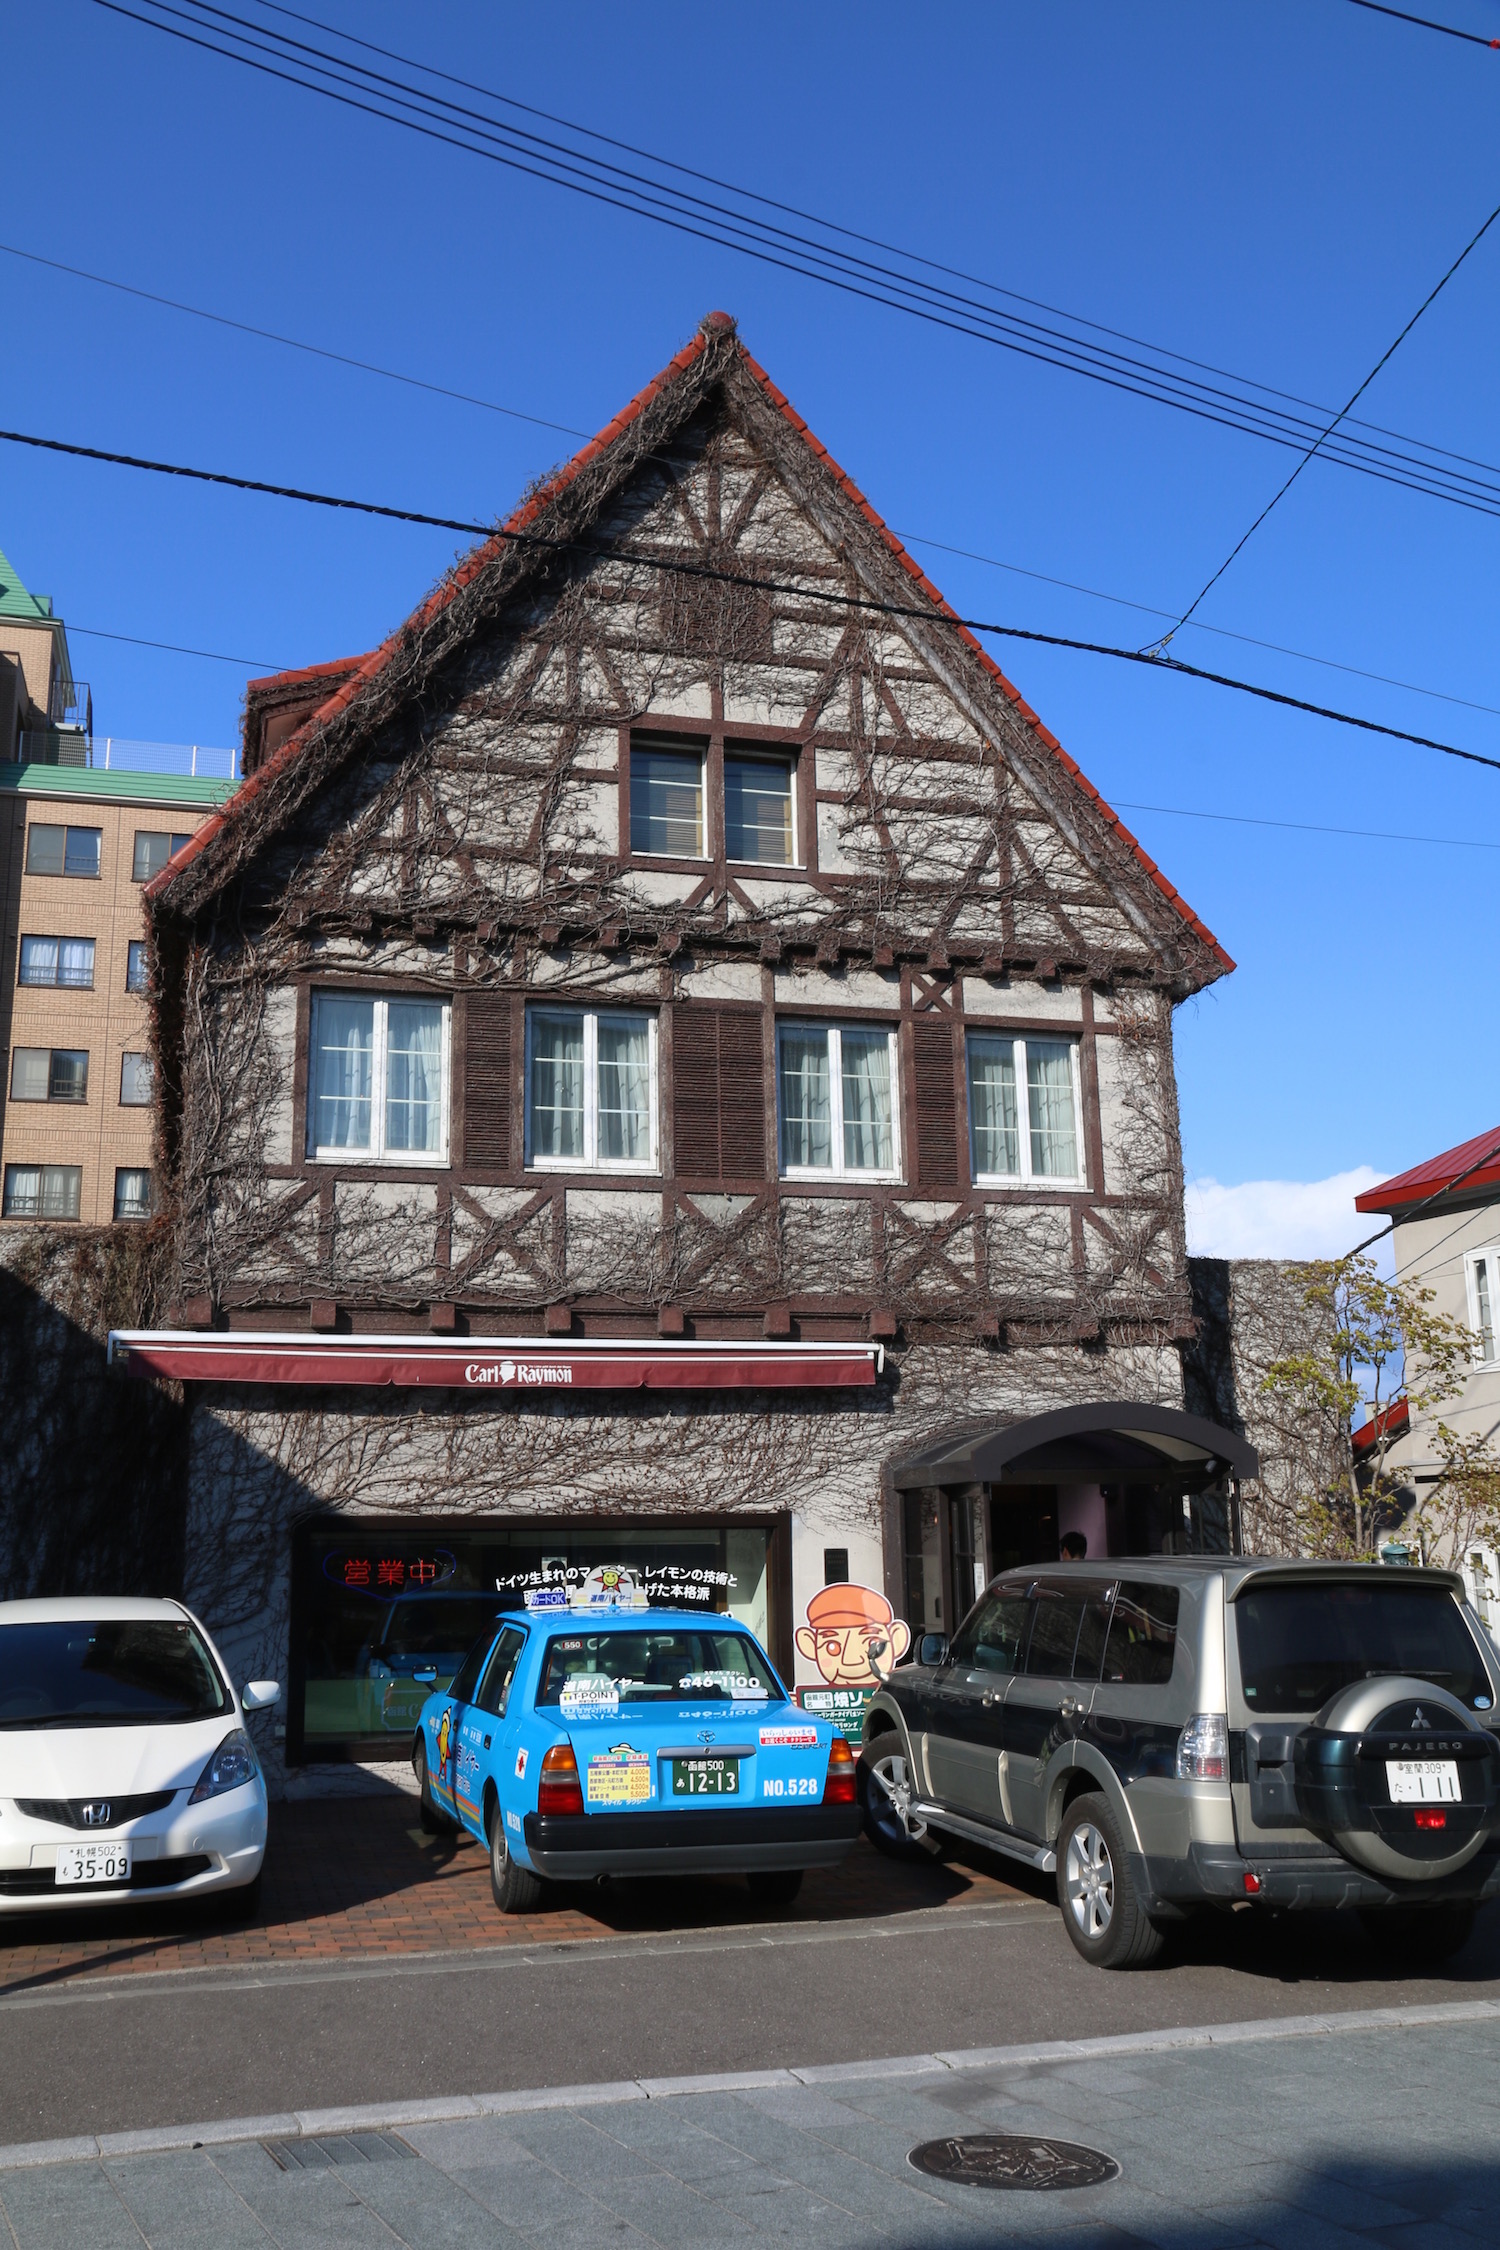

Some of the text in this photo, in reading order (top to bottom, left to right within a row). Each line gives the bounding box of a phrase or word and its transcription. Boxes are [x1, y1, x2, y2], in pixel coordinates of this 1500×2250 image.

[465, 1364, 572, 1385] Carl Raymon
[344, 1559, 435, 1585] 営業中
[564, 1641, 581, 1649] 550
[562, 1678, 644, 1692] 道南ハイヤー
[1389, 1742, 1462, 1751] PAJERO
[676, 1772, 736, 1792] あ 12-13
[764, 1779, 818, 1797] NO.528
[1394, 1783, 1403, 1792] た
[73, 1858, 128, 1879] 35-09
